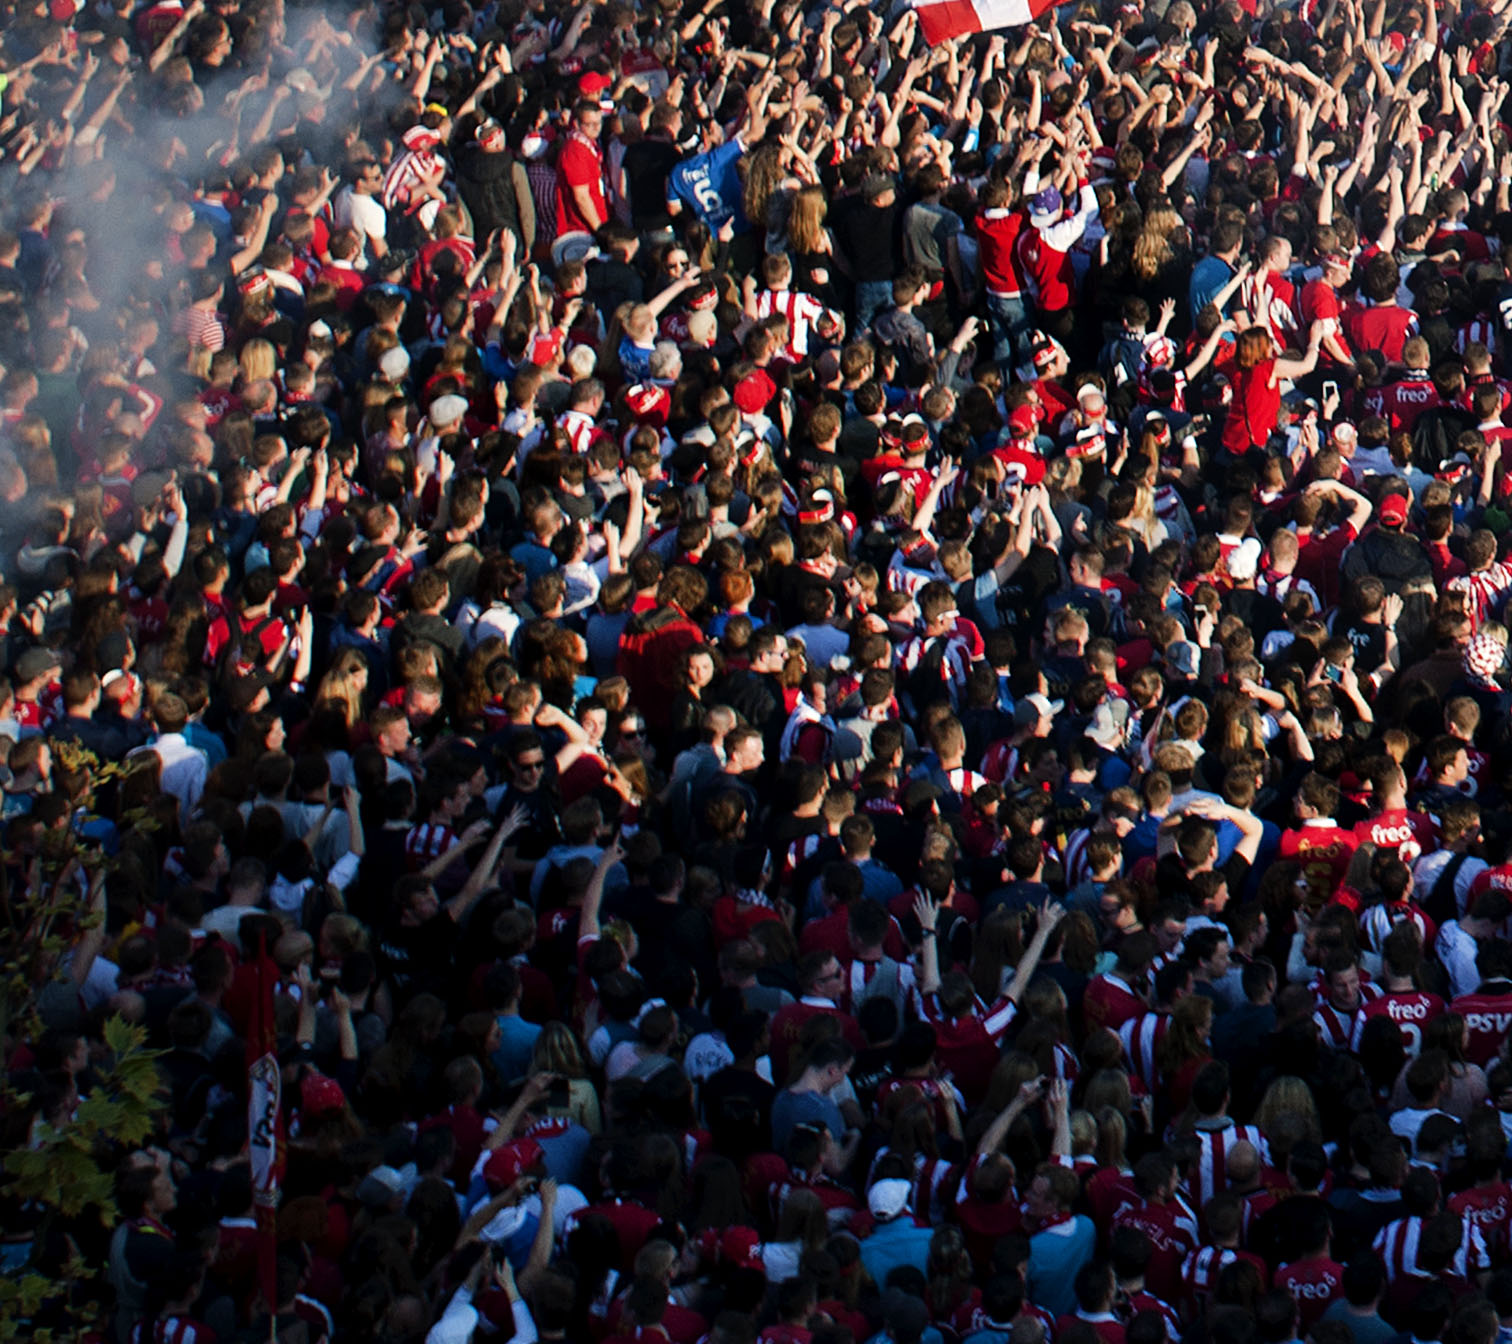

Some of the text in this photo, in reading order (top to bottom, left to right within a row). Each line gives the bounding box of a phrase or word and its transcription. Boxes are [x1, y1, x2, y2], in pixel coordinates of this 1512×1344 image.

[1396, 384, 1433, 404] freo
[1370, 821, 1412, 843] freo
[1387, 994, 1432, 1020] freo
[1463, 1196, 1508, 1224] freo
[1287, 1271, 1337, 1299] freo
